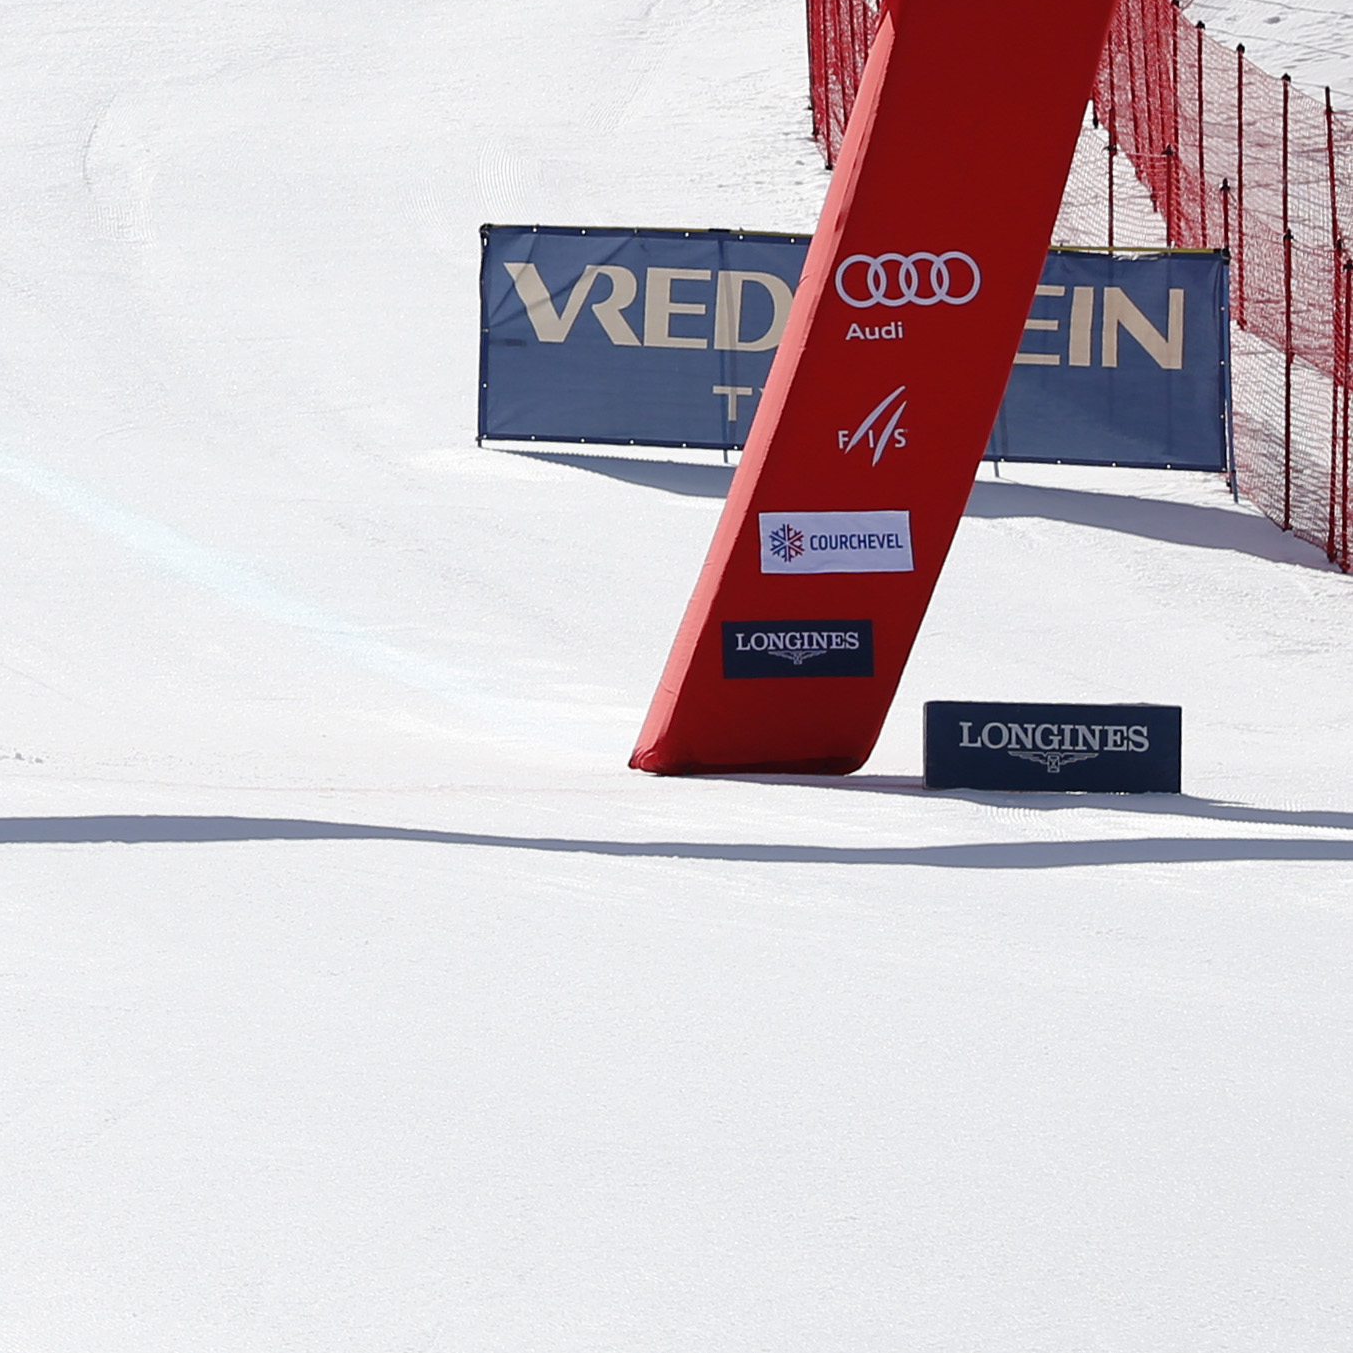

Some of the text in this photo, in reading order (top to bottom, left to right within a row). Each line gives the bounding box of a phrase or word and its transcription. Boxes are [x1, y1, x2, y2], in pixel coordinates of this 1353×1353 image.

[504, 262, 1185, 371] VREDEIN
[845, 322, 903, 340] Audi
[809, 533, 903, 551] COURCHEVEL
[736, 632, 859, 651] LONGINES
[959, 722, 1150, 753] LONGINES
